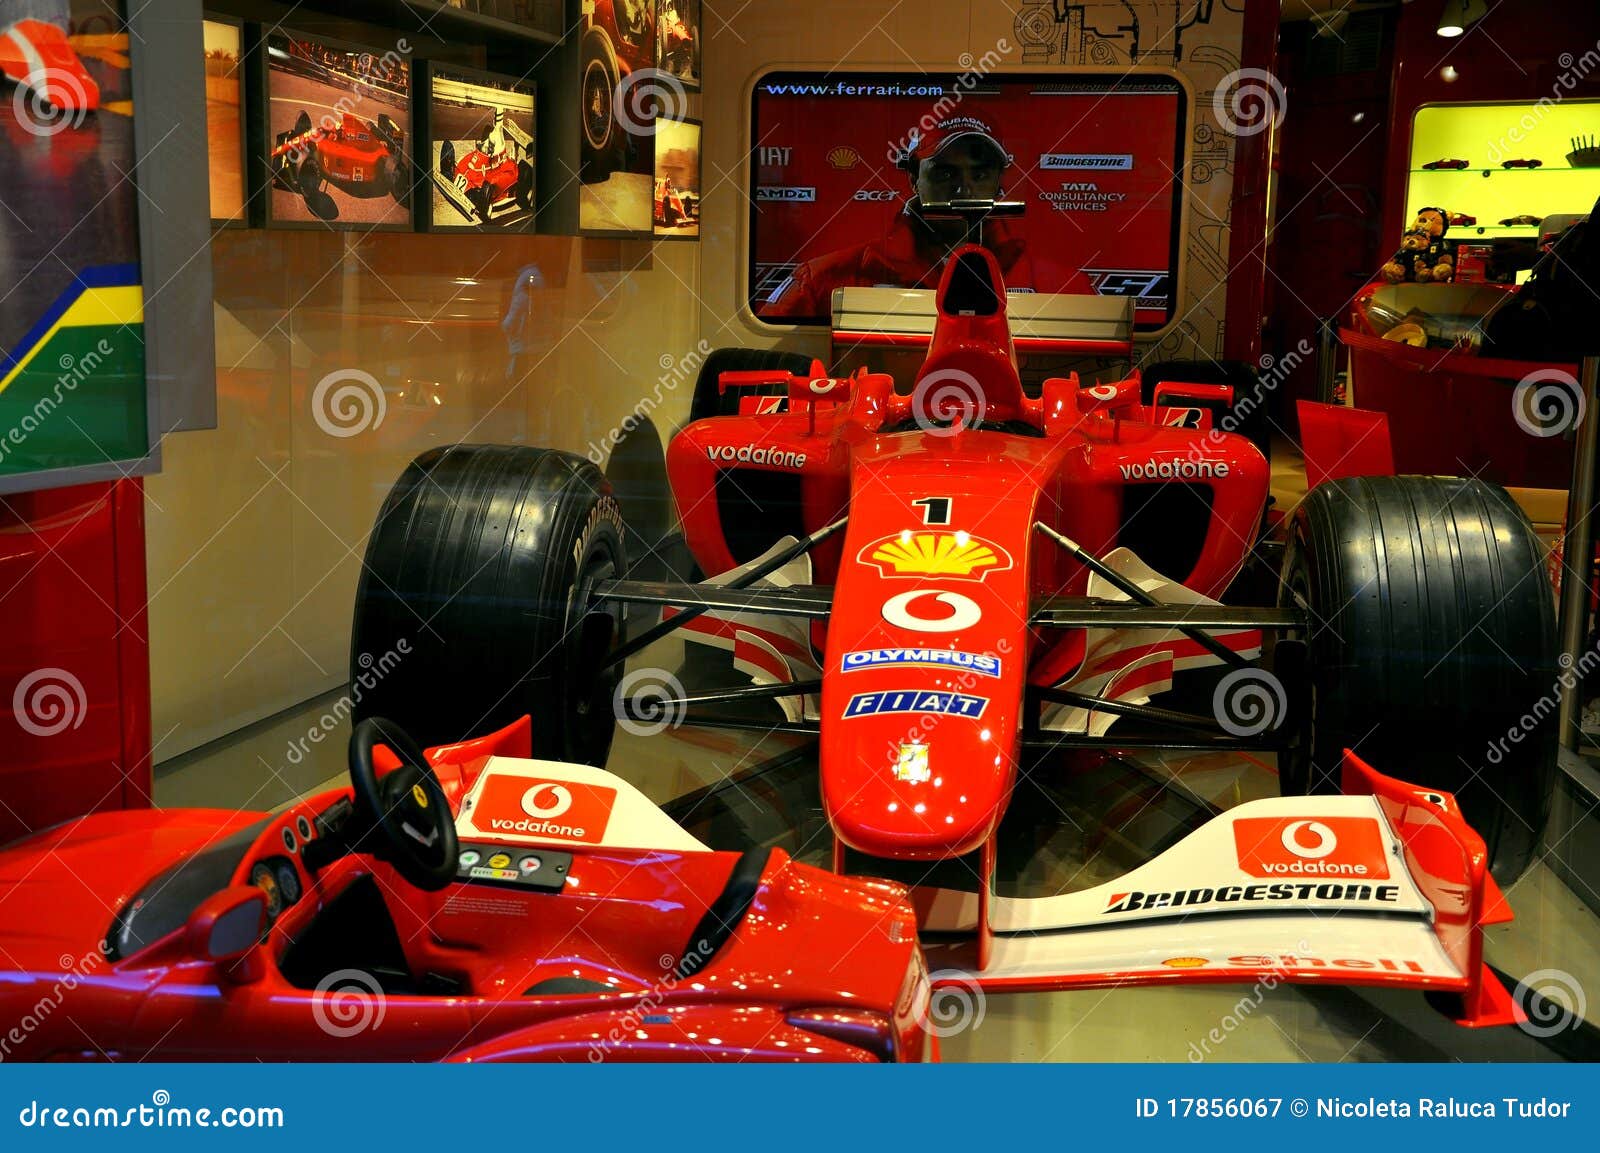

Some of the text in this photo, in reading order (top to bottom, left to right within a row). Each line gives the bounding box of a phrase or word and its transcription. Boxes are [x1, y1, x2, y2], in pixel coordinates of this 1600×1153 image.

[766, 82, 943, 96] www.ferrari.com
[1046, 156, 1126, 167] BRIDGESTONE
[853, 190, 900, 201] acer
[1061, 183, 1098, 191] TATA
[1039, 193, 1126, 201] CONSULTANCY
[1052, 202, 1107, 211] SERVICES
[706, 443, 807, 468] vodafone
[1119, 457, 1230, 480] vodafone
[911, 497, 953, 526] 1
[846, 650, 997, 670] OLYMPUS
[854, 694, 978, 714] FIAT
[490, 818, 586, 838] vodafone
[1261, 859, 1369, 876] vodafone
[1101, 883, 1400, 915] BRIDGESTONE
[1226, 955, 1425, 973] Shell
